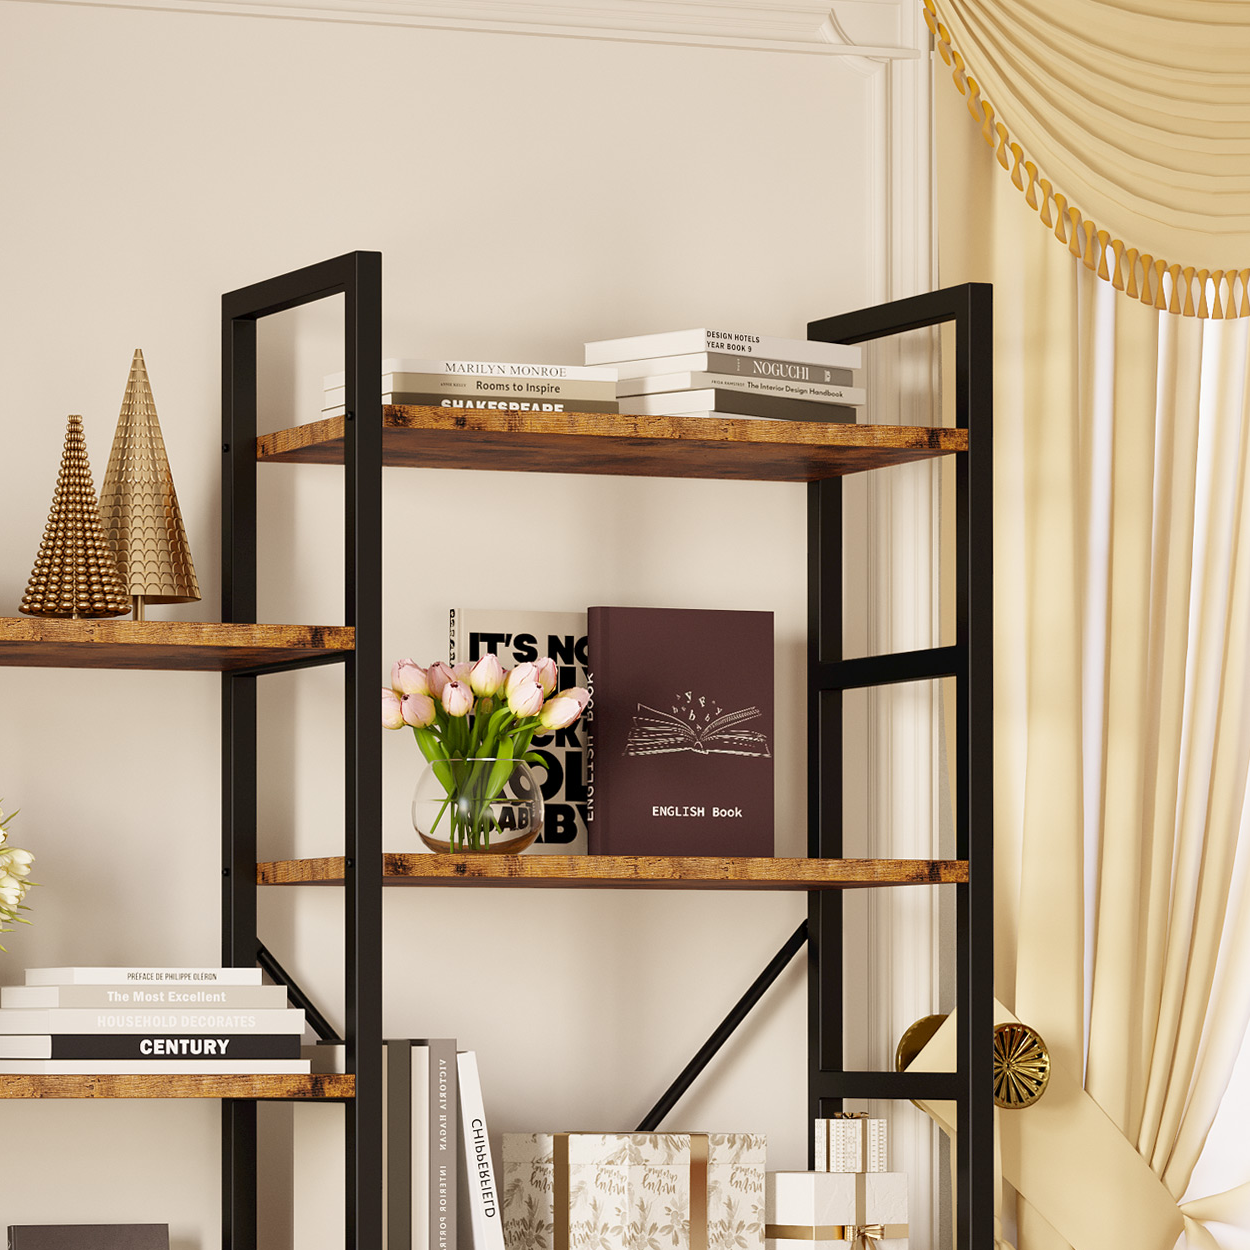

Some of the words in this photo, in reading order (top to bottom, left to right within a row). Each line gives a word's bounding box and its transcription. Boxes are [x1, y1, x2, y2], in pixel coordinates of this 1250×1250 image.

[707, 331, 733, 341] DESIGN
[735, 333, 760, 343] HOTELS
[707, 342, 725, 350] YEAR
[727, 343, 746, 352] BOOK
[445, 363, 506, 374] MARILYN
[510, 365, 567, 377] MONROE
[753, 360, 809, 380] NOGUCHI
[476, 381, 509, 391] Rooms
[512, 382, 523, 392] to
[526, 383, 560, 394] Inspire
[760, 383, 784, 392] Interior
[786, 386, 807, 396] Design
[809, 388, 843, 398] Handbook
[653, 806, 705, 817] ENGLISH
[713, 807, 743, 818] Book
[156, 973, 163, 981] DE
[165, 973, 192, 981] PHILIPPE
[107, 992, 130, 1002] The
[134, 992, 164, 1002] Most
[168, 992, 226, 1002] Excellent
[98, 1016, 177, 1028] HOUSEHOLD
[182, 1016, 256, 1028] DECORATES
[140, 1039, 230, 1055] CENTURY
